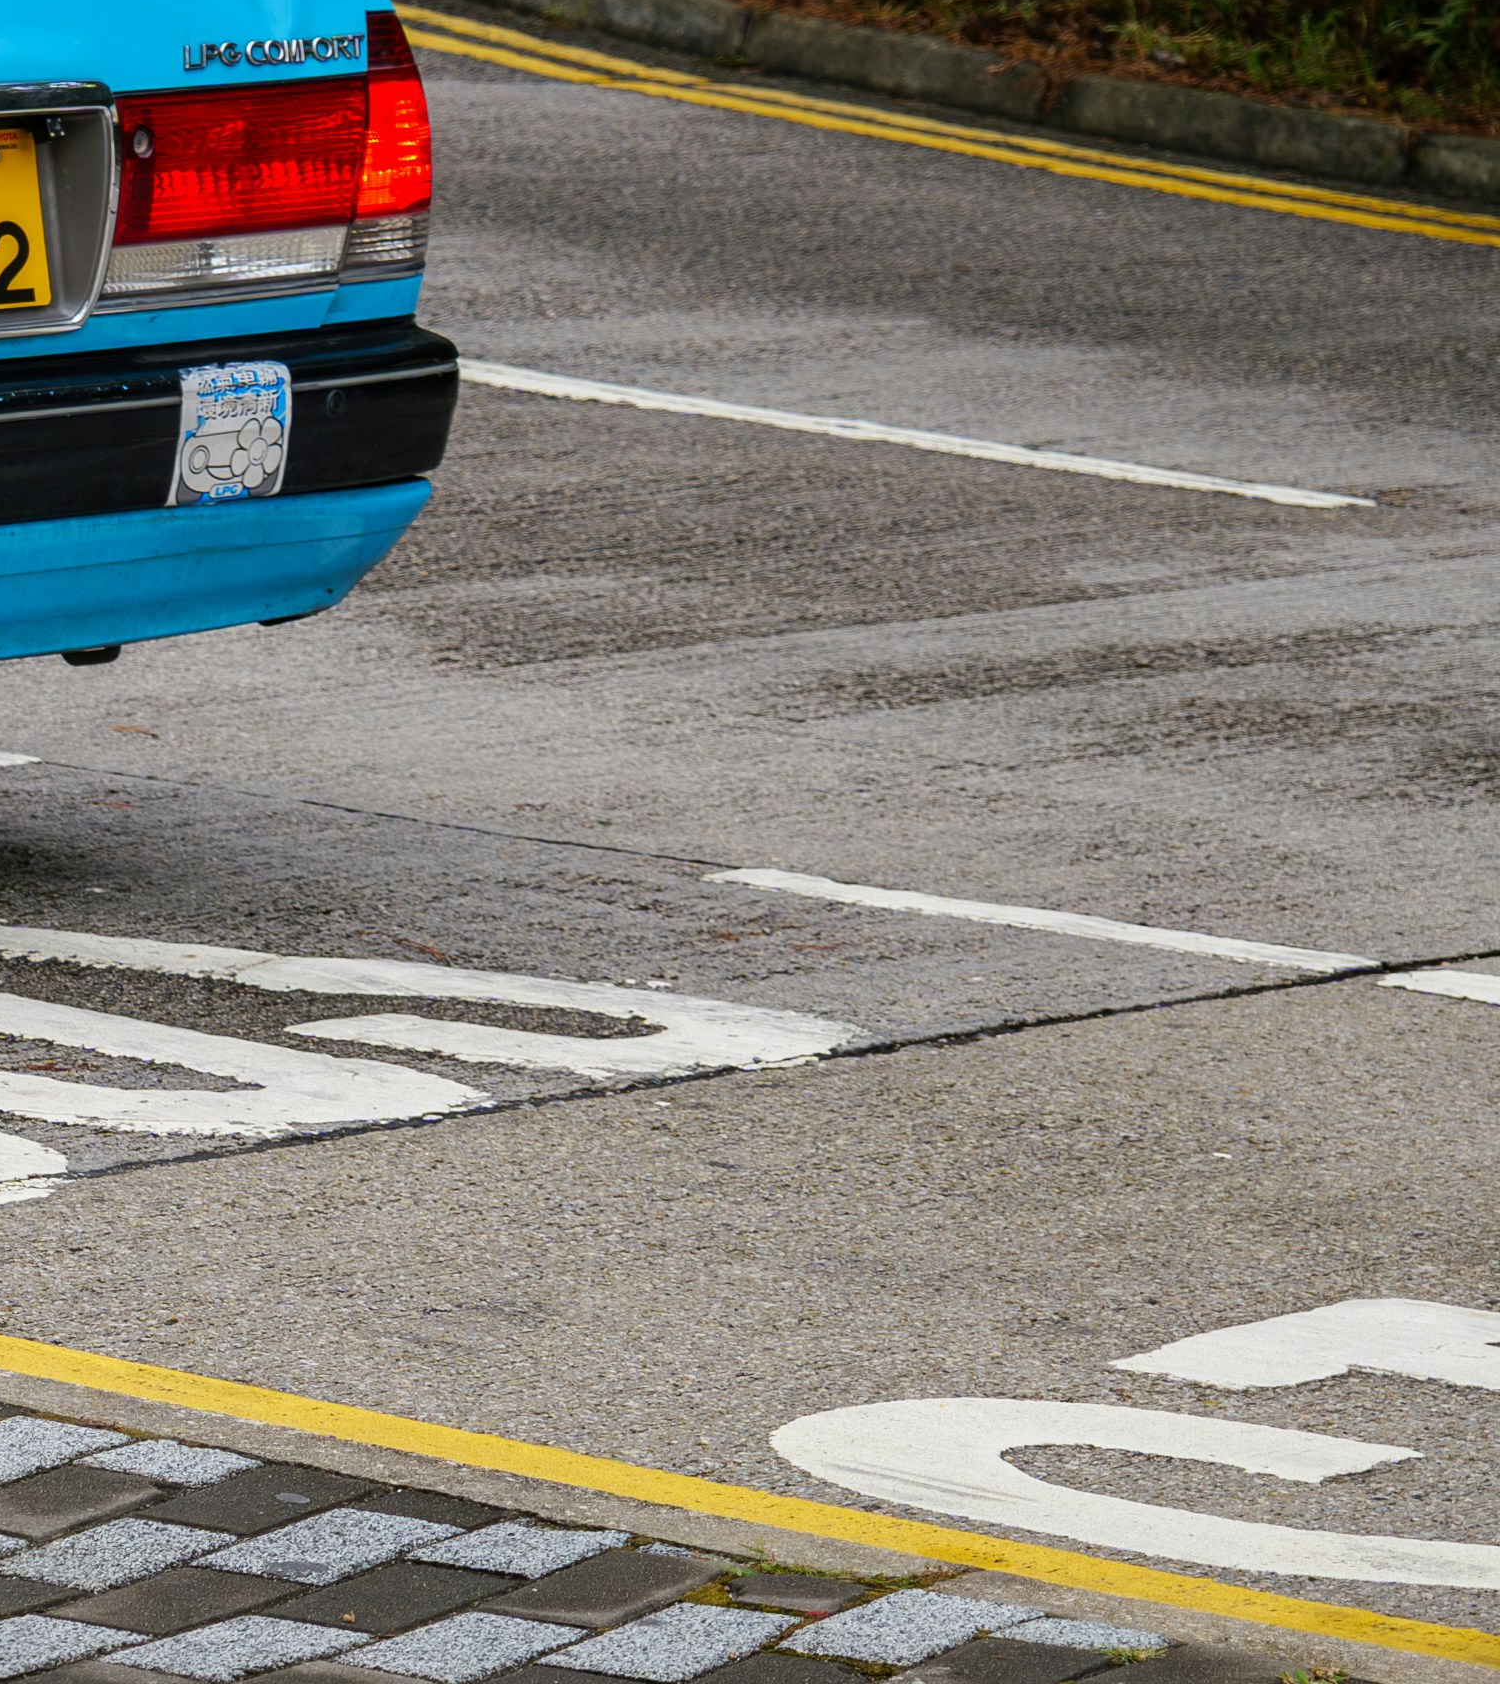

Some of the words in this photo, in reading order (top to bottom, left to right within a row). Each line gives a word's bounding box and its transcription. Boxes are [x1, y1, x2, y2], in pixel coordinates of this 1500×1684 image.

[183, 41, 242, 71] LPG
[245, 33, 365, 66] COMFORT
[215, 485, 239, 497] LPG
